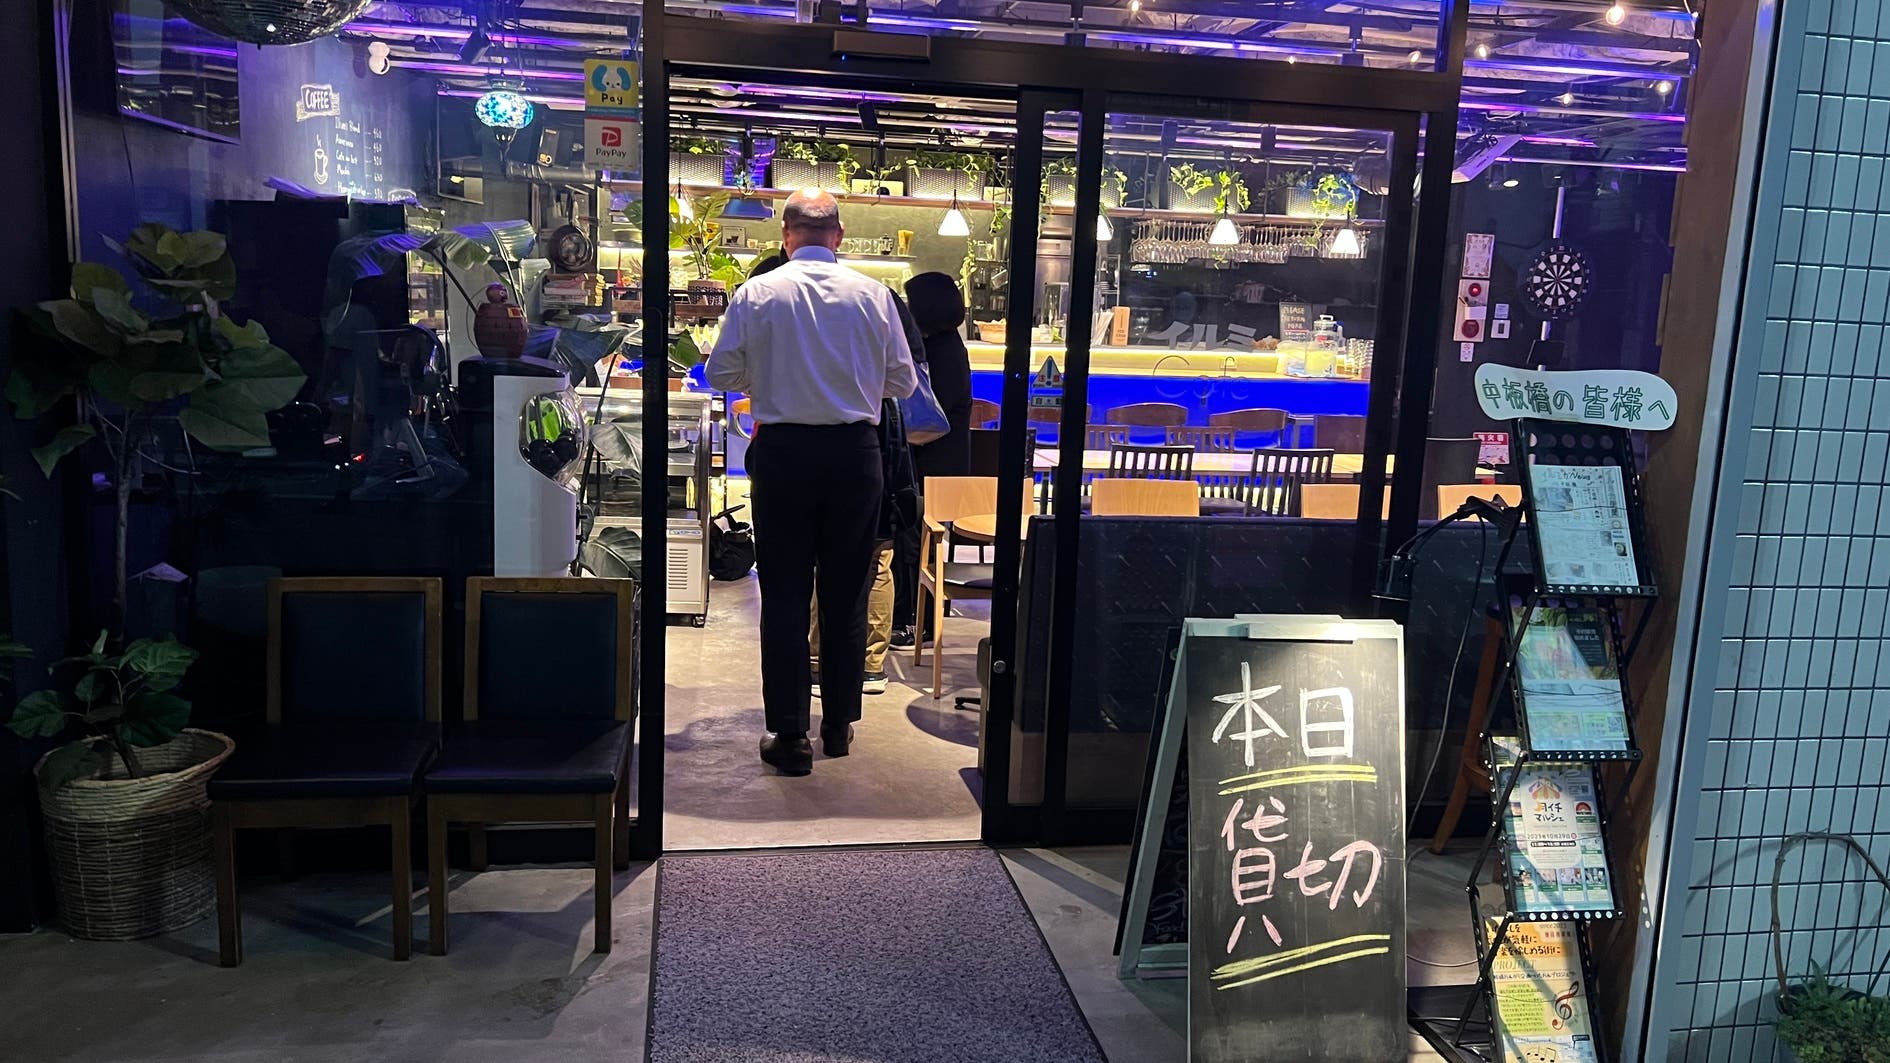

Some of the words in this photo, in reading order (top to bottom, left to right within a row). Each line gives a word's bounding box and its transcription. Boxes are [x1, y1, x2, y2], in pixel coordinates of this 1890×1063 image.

[305, 88, 330, 110] COFFEE
[601, 93, 624, 105] Pay
[595, 147, 627, 158] PayPay
[1148, 321, 1257, 352] イルミ
[1211, 661, 1355, 767] 本日
[1533, 813, 1565, 822] マルシェ
[1220, 795, 1383, 955] 貸切
